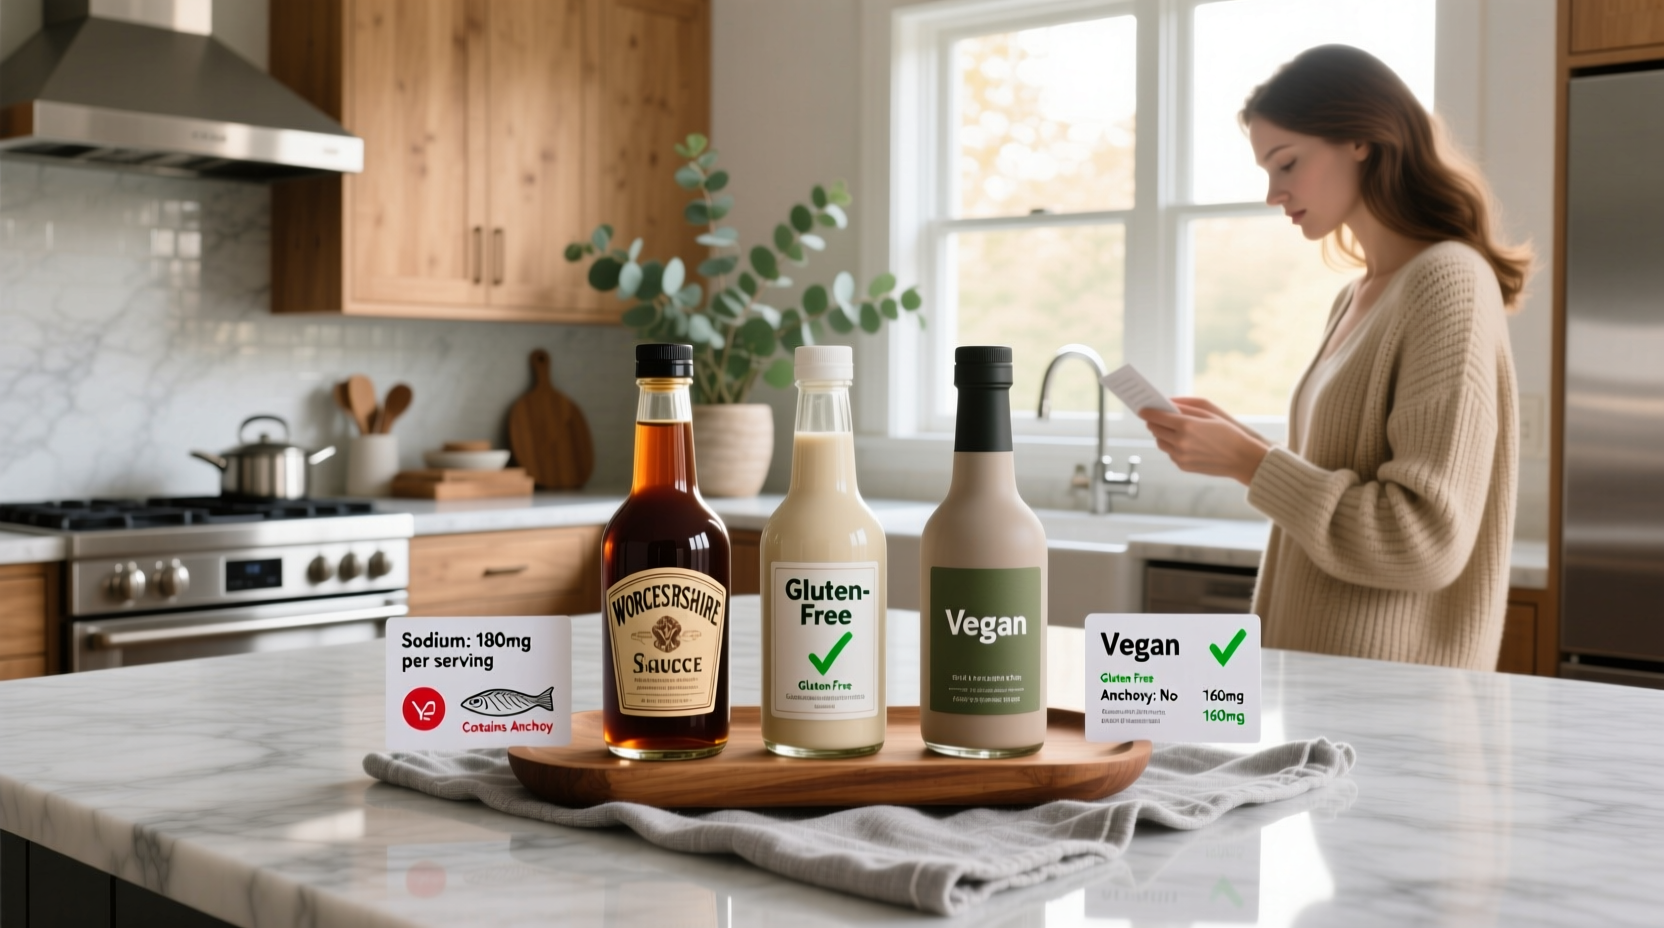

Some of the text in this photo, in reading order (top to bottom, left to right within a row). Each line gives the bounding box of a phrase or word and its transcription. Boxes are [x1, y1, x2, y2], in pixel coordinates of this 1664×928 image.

[785, 578, 870, 601] Gluten-
[801, 603, 852, 625] Free
[945, 609, 1027, 644] Vegan
[402, 632, 531, 652] Sodium: 180mg
[1101, 632, 1180, 662] Vegan
[402, 654, 494, 672] per serving
[1160, 689, 1179, 701] No
[1203, 689, 1244, 705] 160mg
[1203, 709, 1245, 725] 160mg
